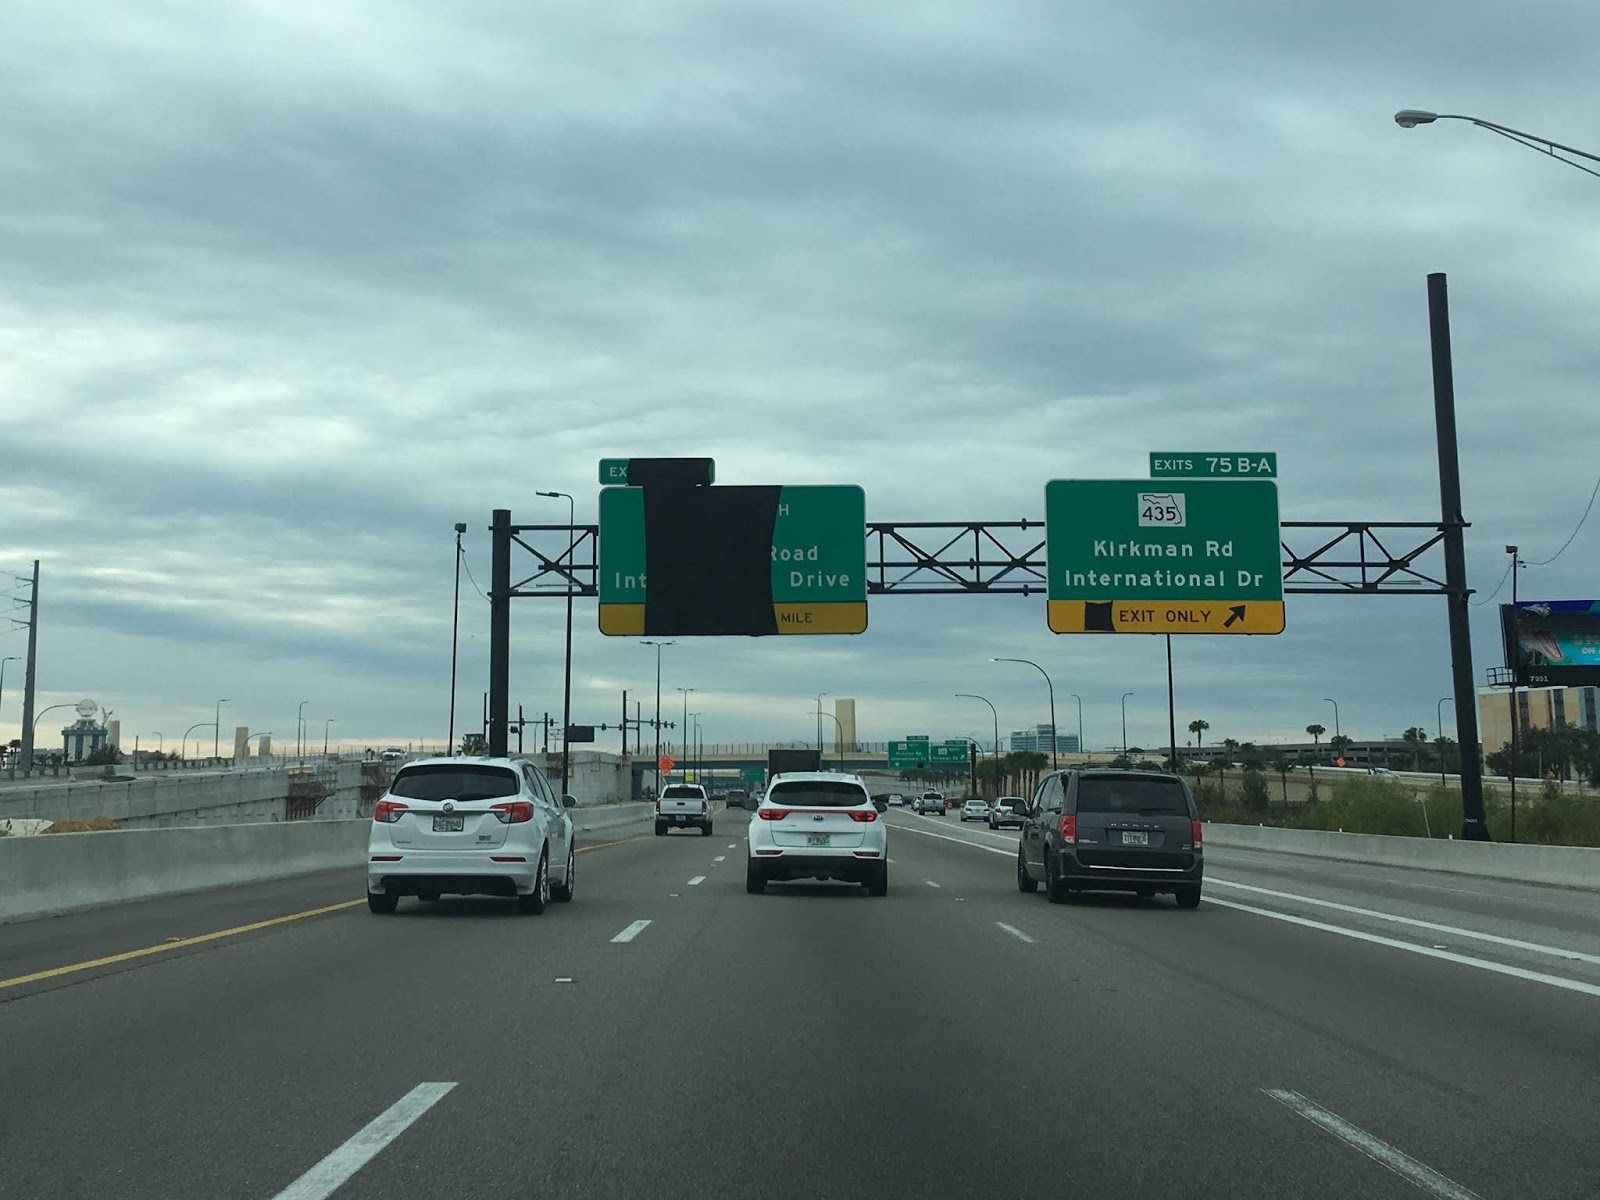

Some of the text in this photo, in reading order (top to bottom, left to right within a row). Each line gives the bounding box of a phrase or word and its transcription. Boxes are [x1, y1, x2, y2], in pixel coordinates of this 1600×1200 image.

[610, 466, 628, 478] EX
[1154, 457, 1272, 473] EXITS 75 B-A
[1142, 506, 1176, 521] 435
[1094, 540, 1233, 557] Kirkman Rd
[790, 571, 850, 587] Drive
[1065, 570, 1263, 587] International Dr
[781, 612, 812, 624] MILE
[1120, 610, 1212, 623] EXIT ONLY
